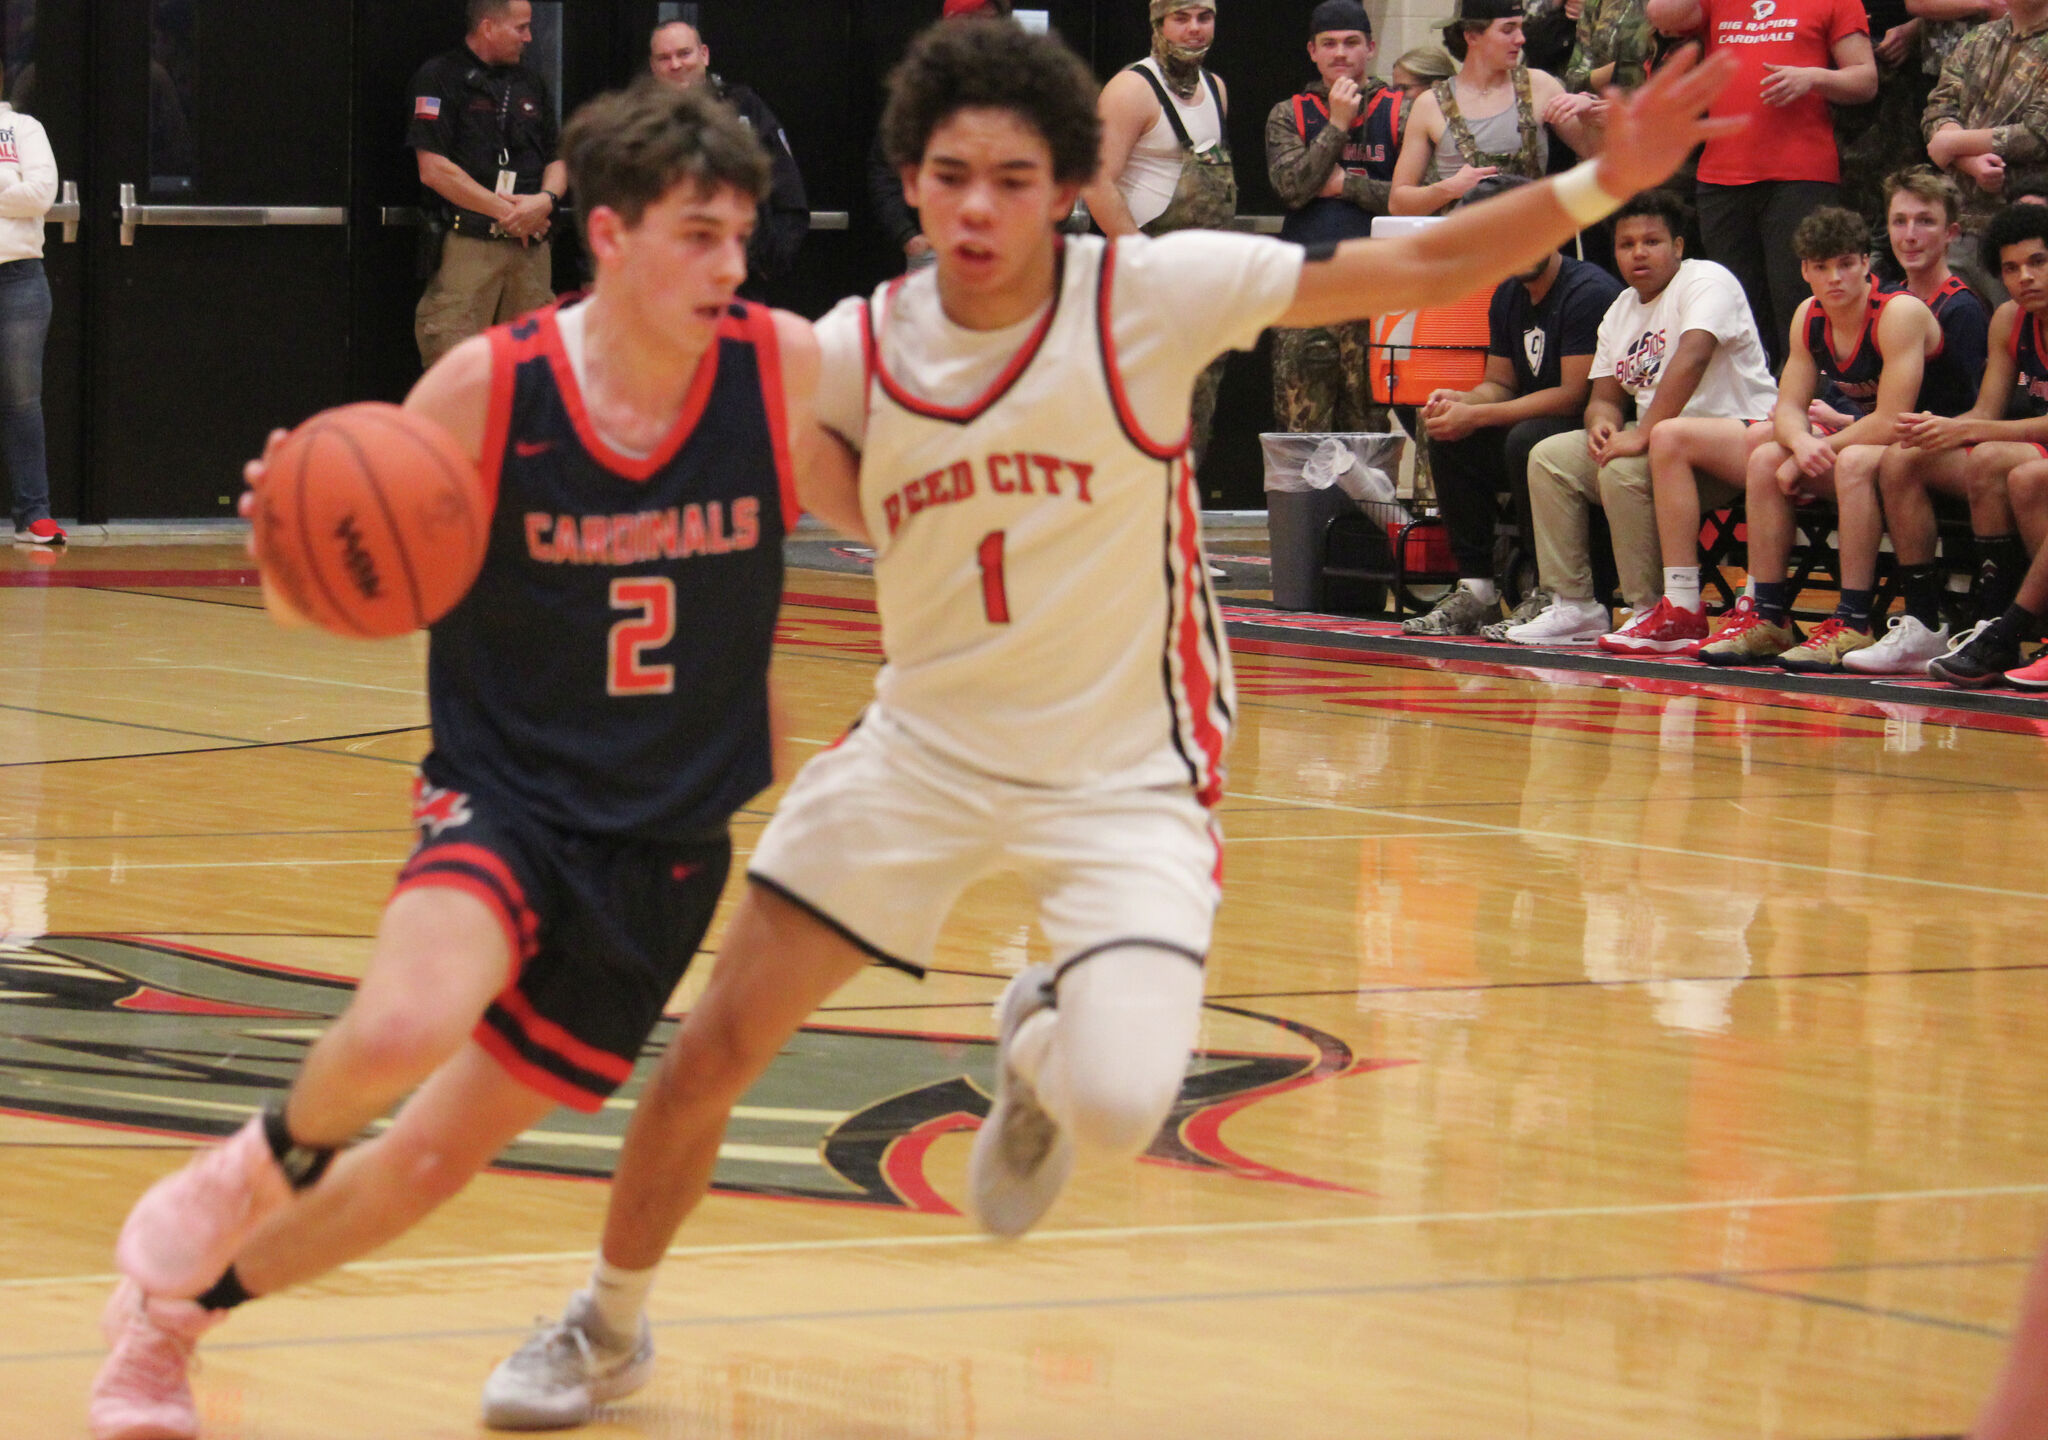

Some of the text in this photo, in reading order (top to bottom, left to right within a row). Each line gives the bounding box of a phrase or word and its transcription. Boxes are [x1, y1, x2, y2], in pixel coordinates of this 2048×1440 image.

[1718, 18, 1798, 31] BIG RAPIDS
[1718, 32, 1795, 44] CARDINALS
[987, 453, 1094, 503] CITY
[524, 497, 760, 565] CARDINALS
[977, 530, 1010, 624] 1
[607, 576, 676, 696] 2
